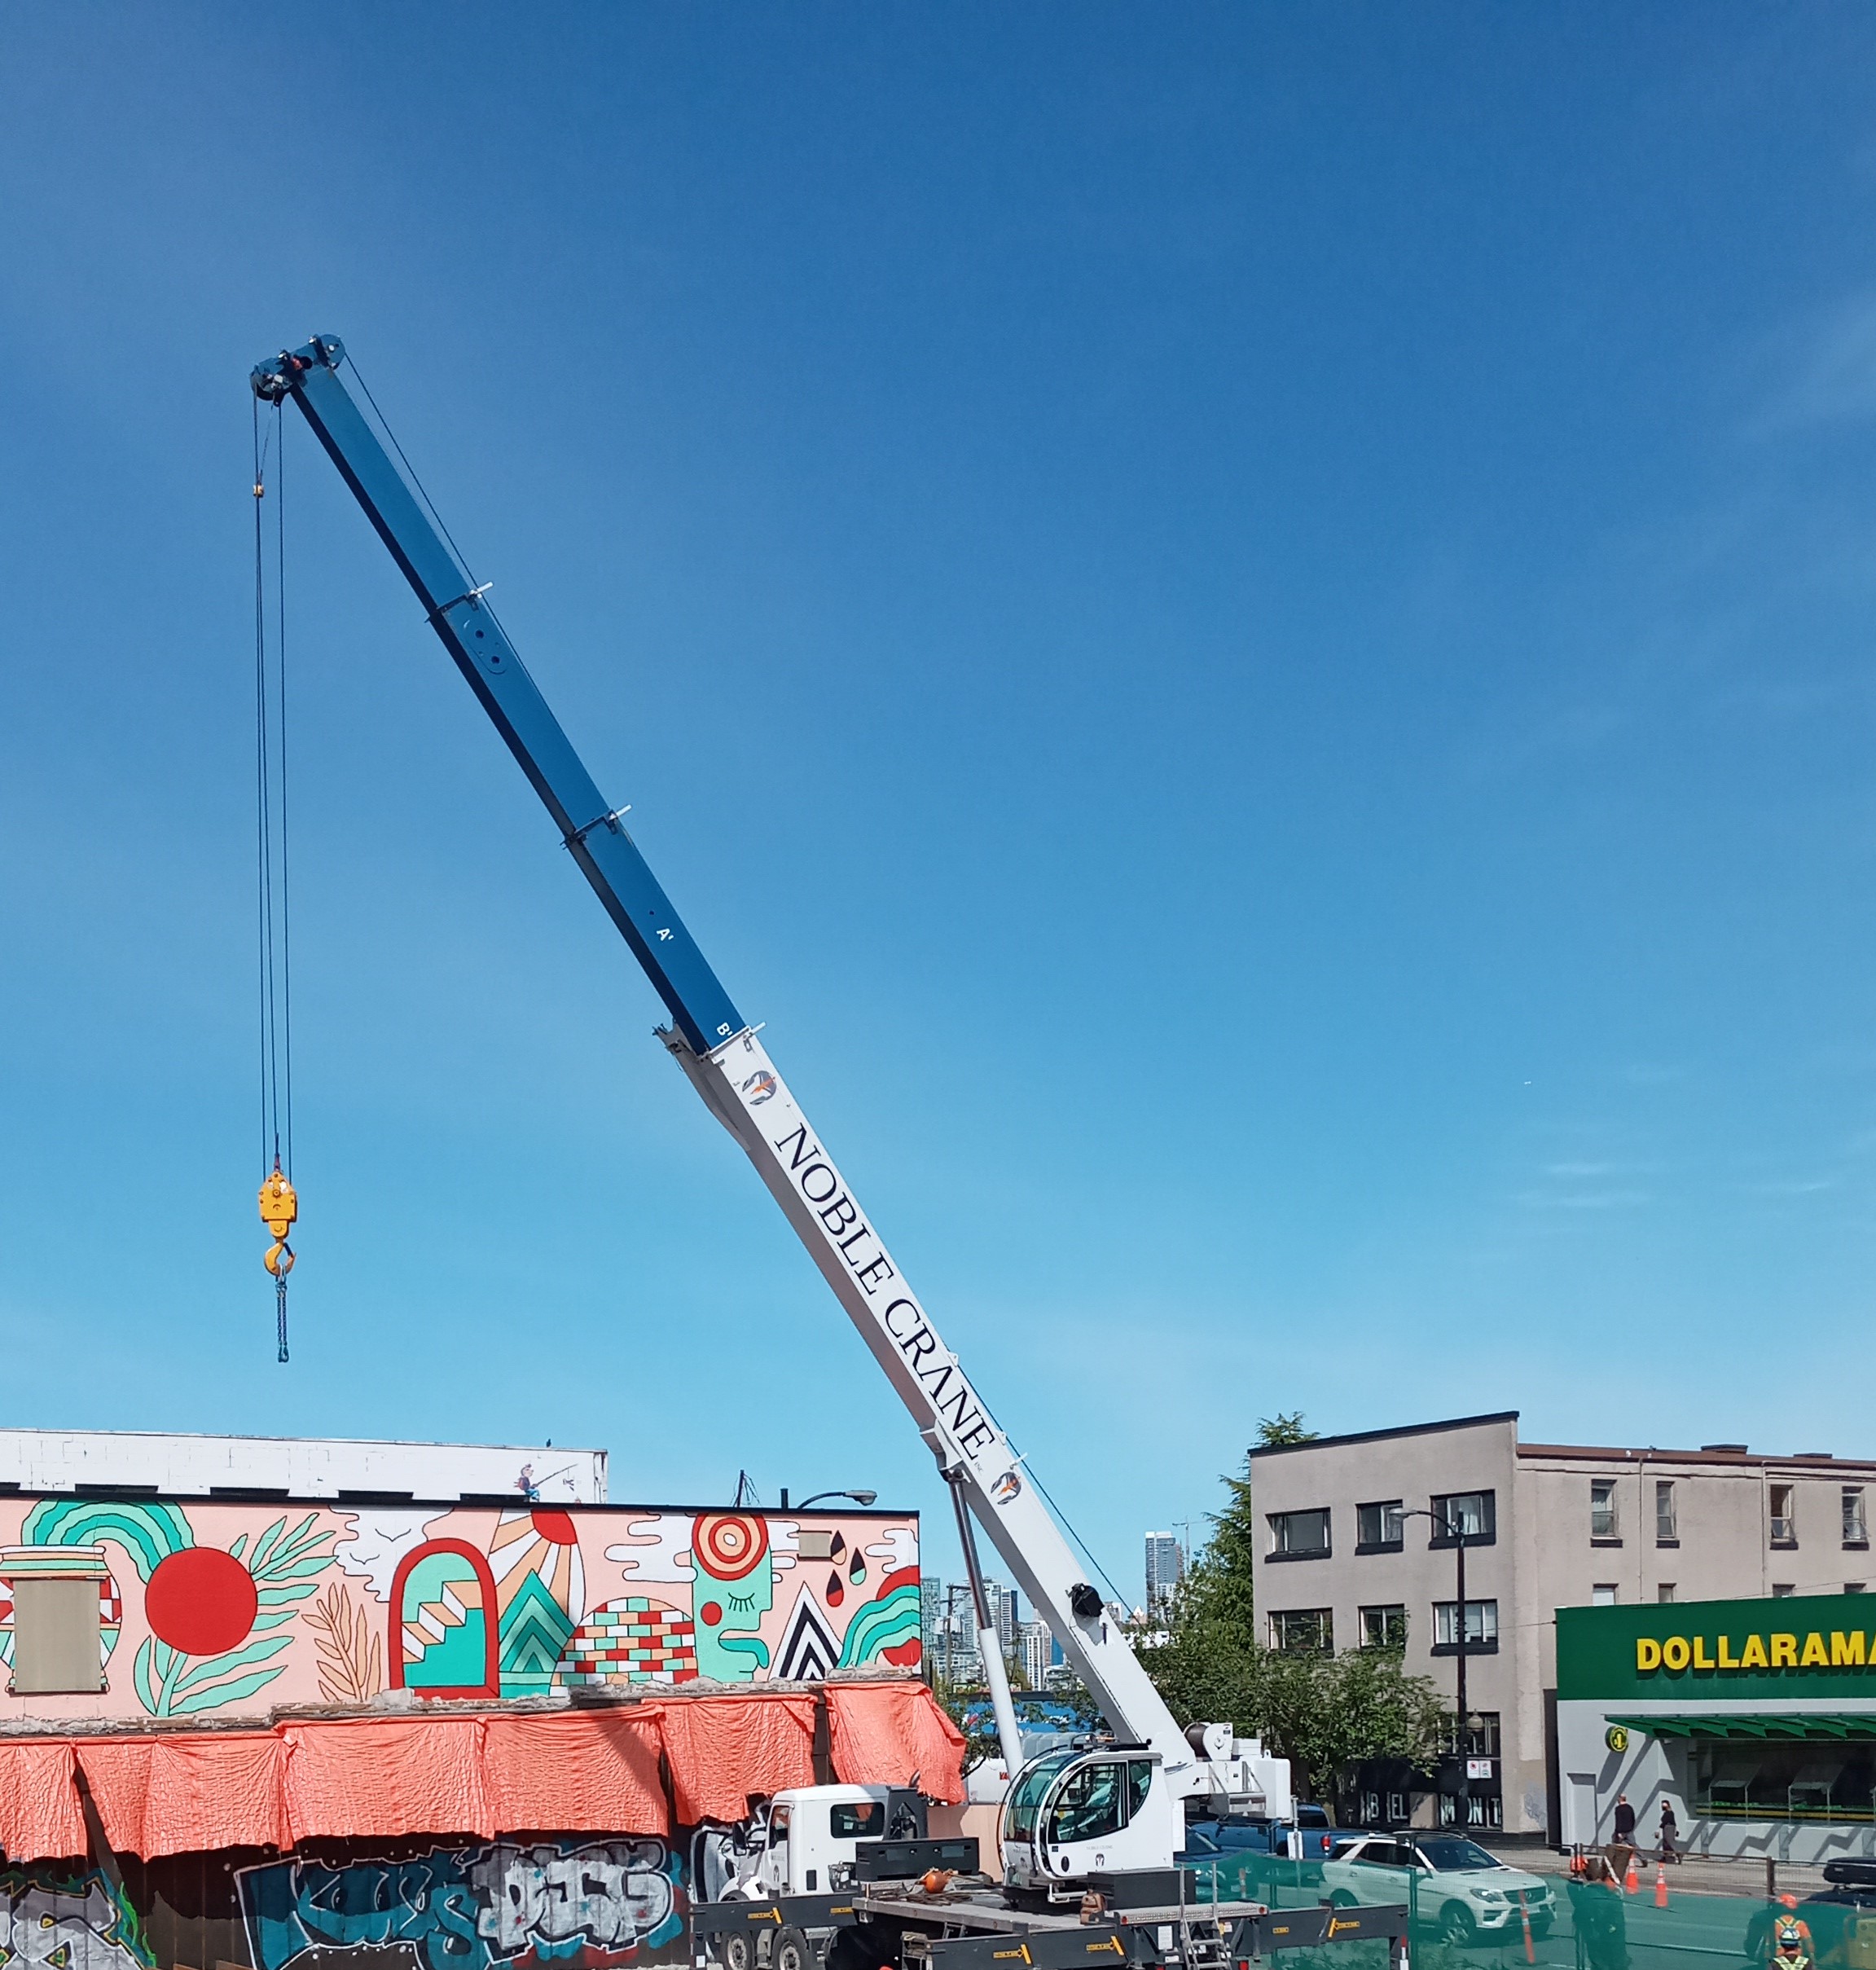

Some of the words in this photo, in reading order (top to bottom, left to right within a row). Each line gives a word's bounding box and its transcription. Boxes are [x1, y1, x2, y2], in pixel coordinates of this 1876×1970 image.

[774, 1122, 894, 1295] NOBLE
[885, 1299, 995, 1460] CRANE
[1637, 1630, 1876, 1670] DOLLARAM
